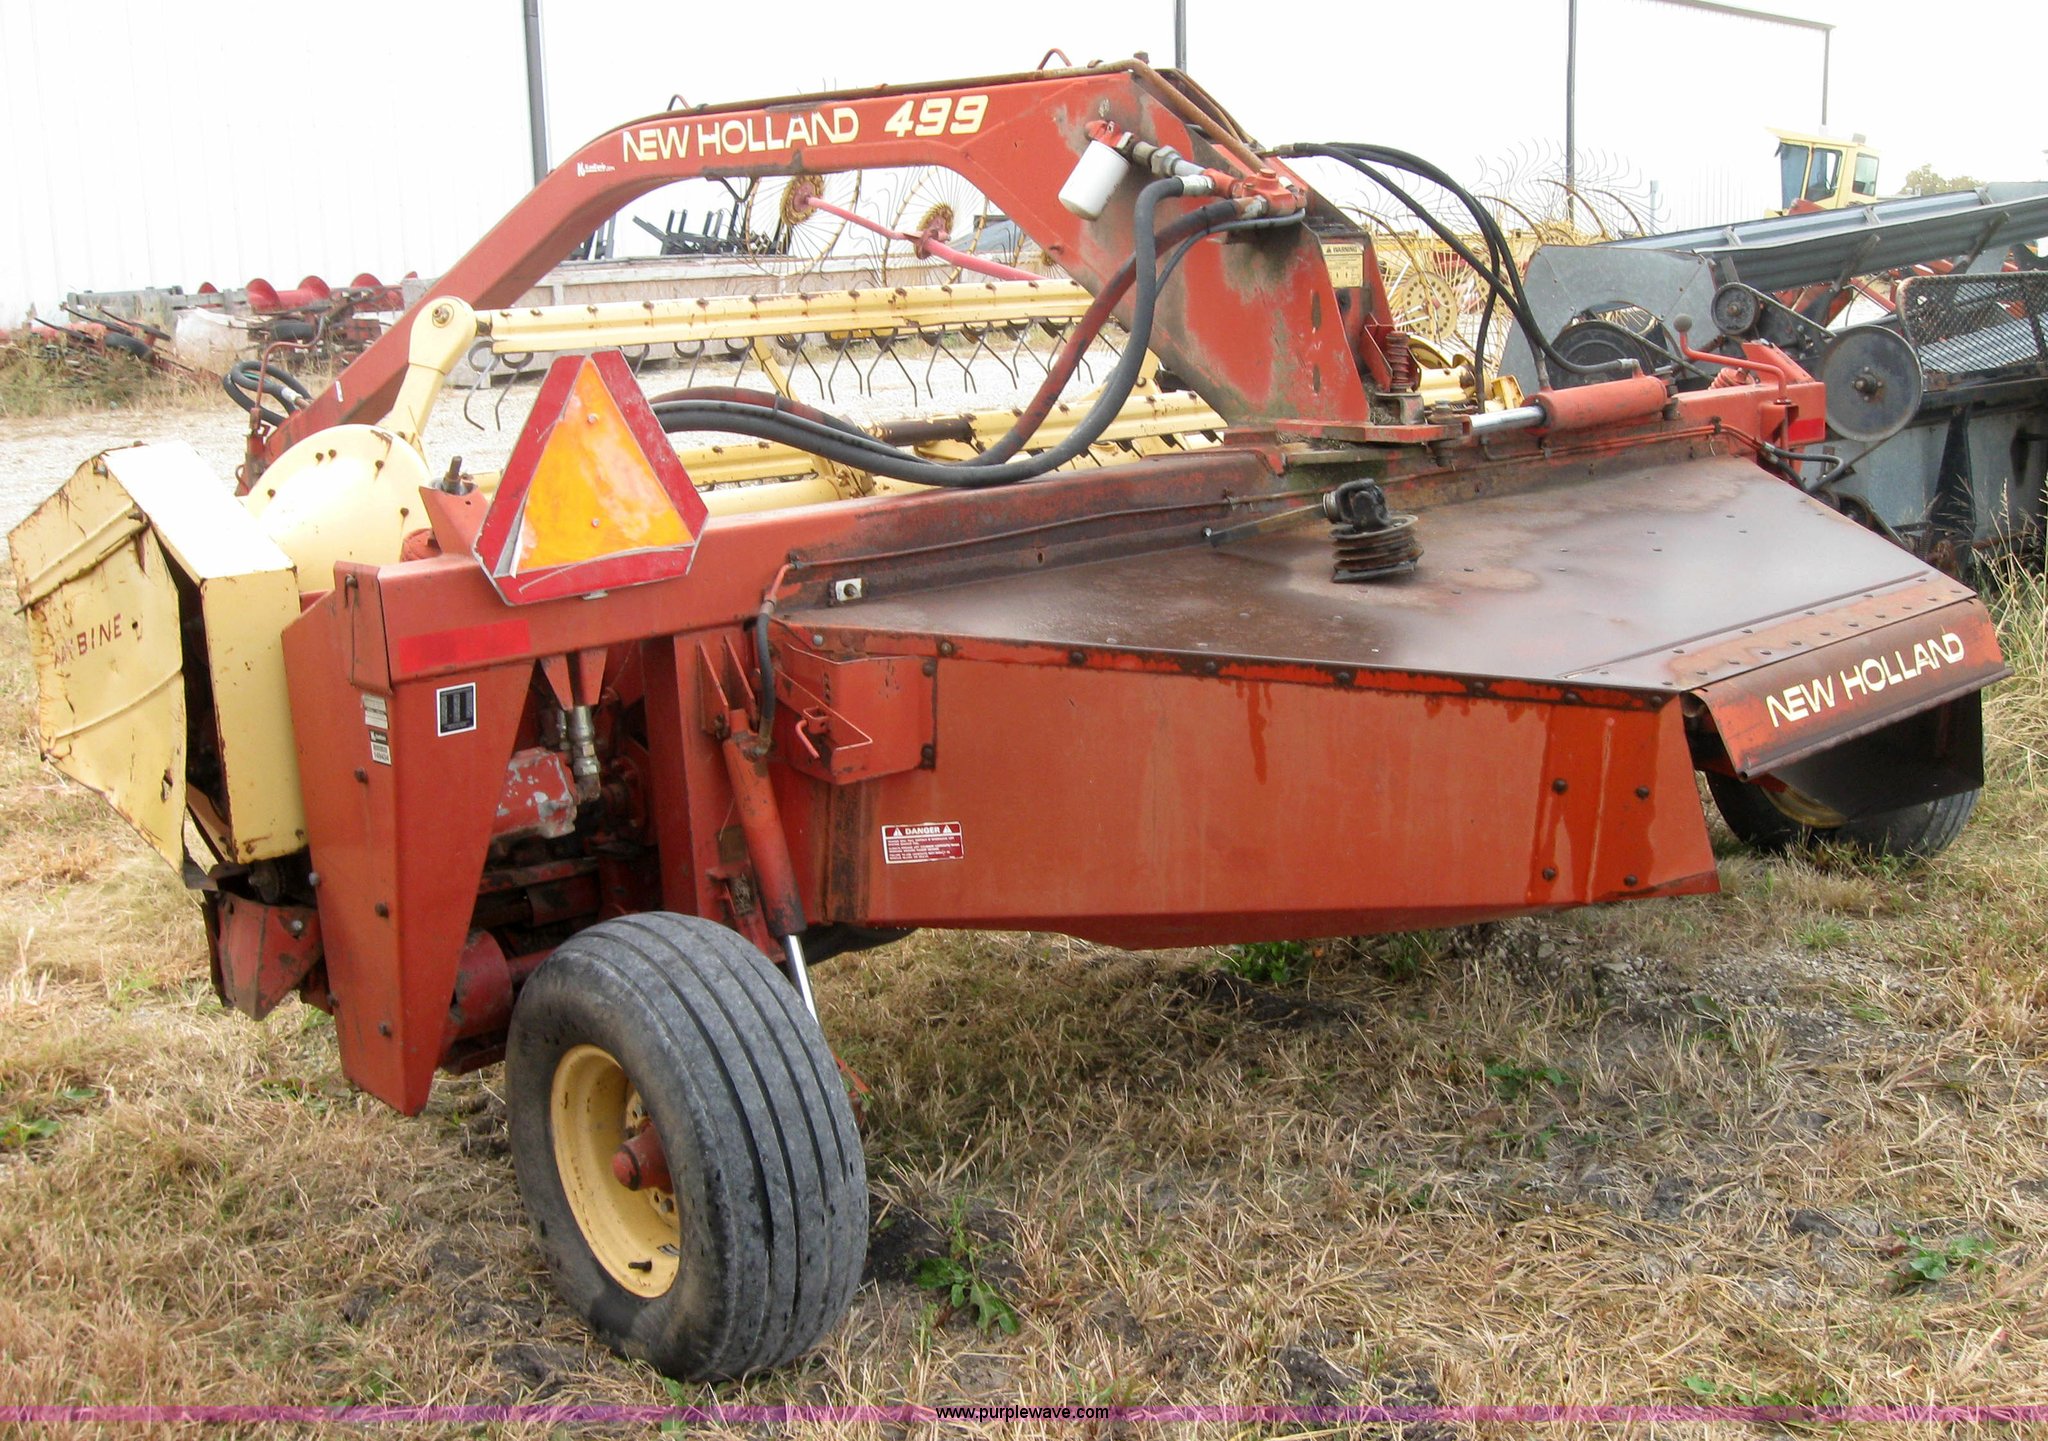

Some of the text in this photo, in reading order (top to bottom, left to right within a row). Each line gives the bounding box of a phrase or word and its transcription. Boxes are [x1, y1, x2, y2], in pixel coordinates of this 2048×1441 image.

[622, 94, 989, 163] NEW HOLLAND 499
[1765, 632, 1965, 728] NEW HOLLAND
[904, 826, 941, 836] DANGER
